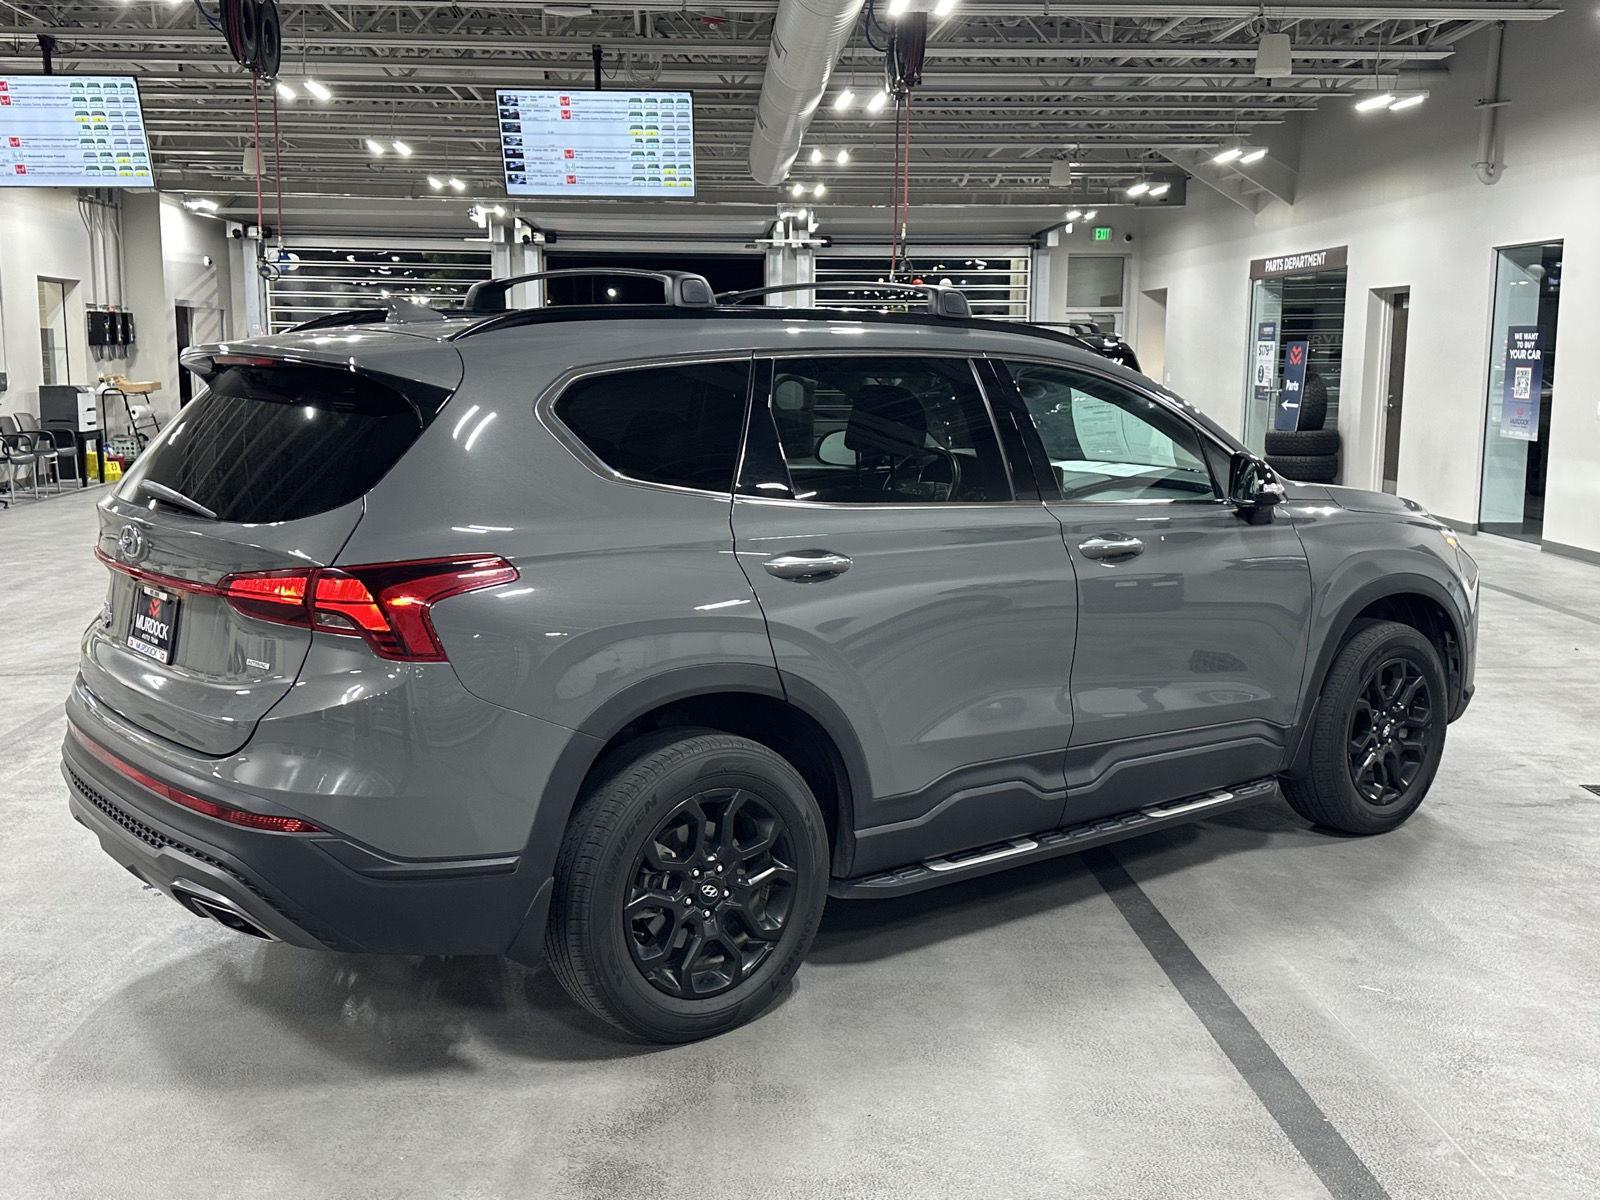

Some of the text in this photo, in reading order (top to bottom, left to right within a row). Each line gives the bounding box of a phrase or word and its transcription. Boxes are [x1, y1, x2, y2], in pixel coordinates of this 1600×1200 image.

[1265, 252, 1326, 272] PARTS DEPARTMENT
[1514, 332, 1539, 340] WE WANT
[1525, 341, 1535, 349] BUY
[1510, 349, 1541, 359] YOUR CAR
[1285, 380, 1299, 391] Parts
[135, 613, 168, 640] MURDOCK
